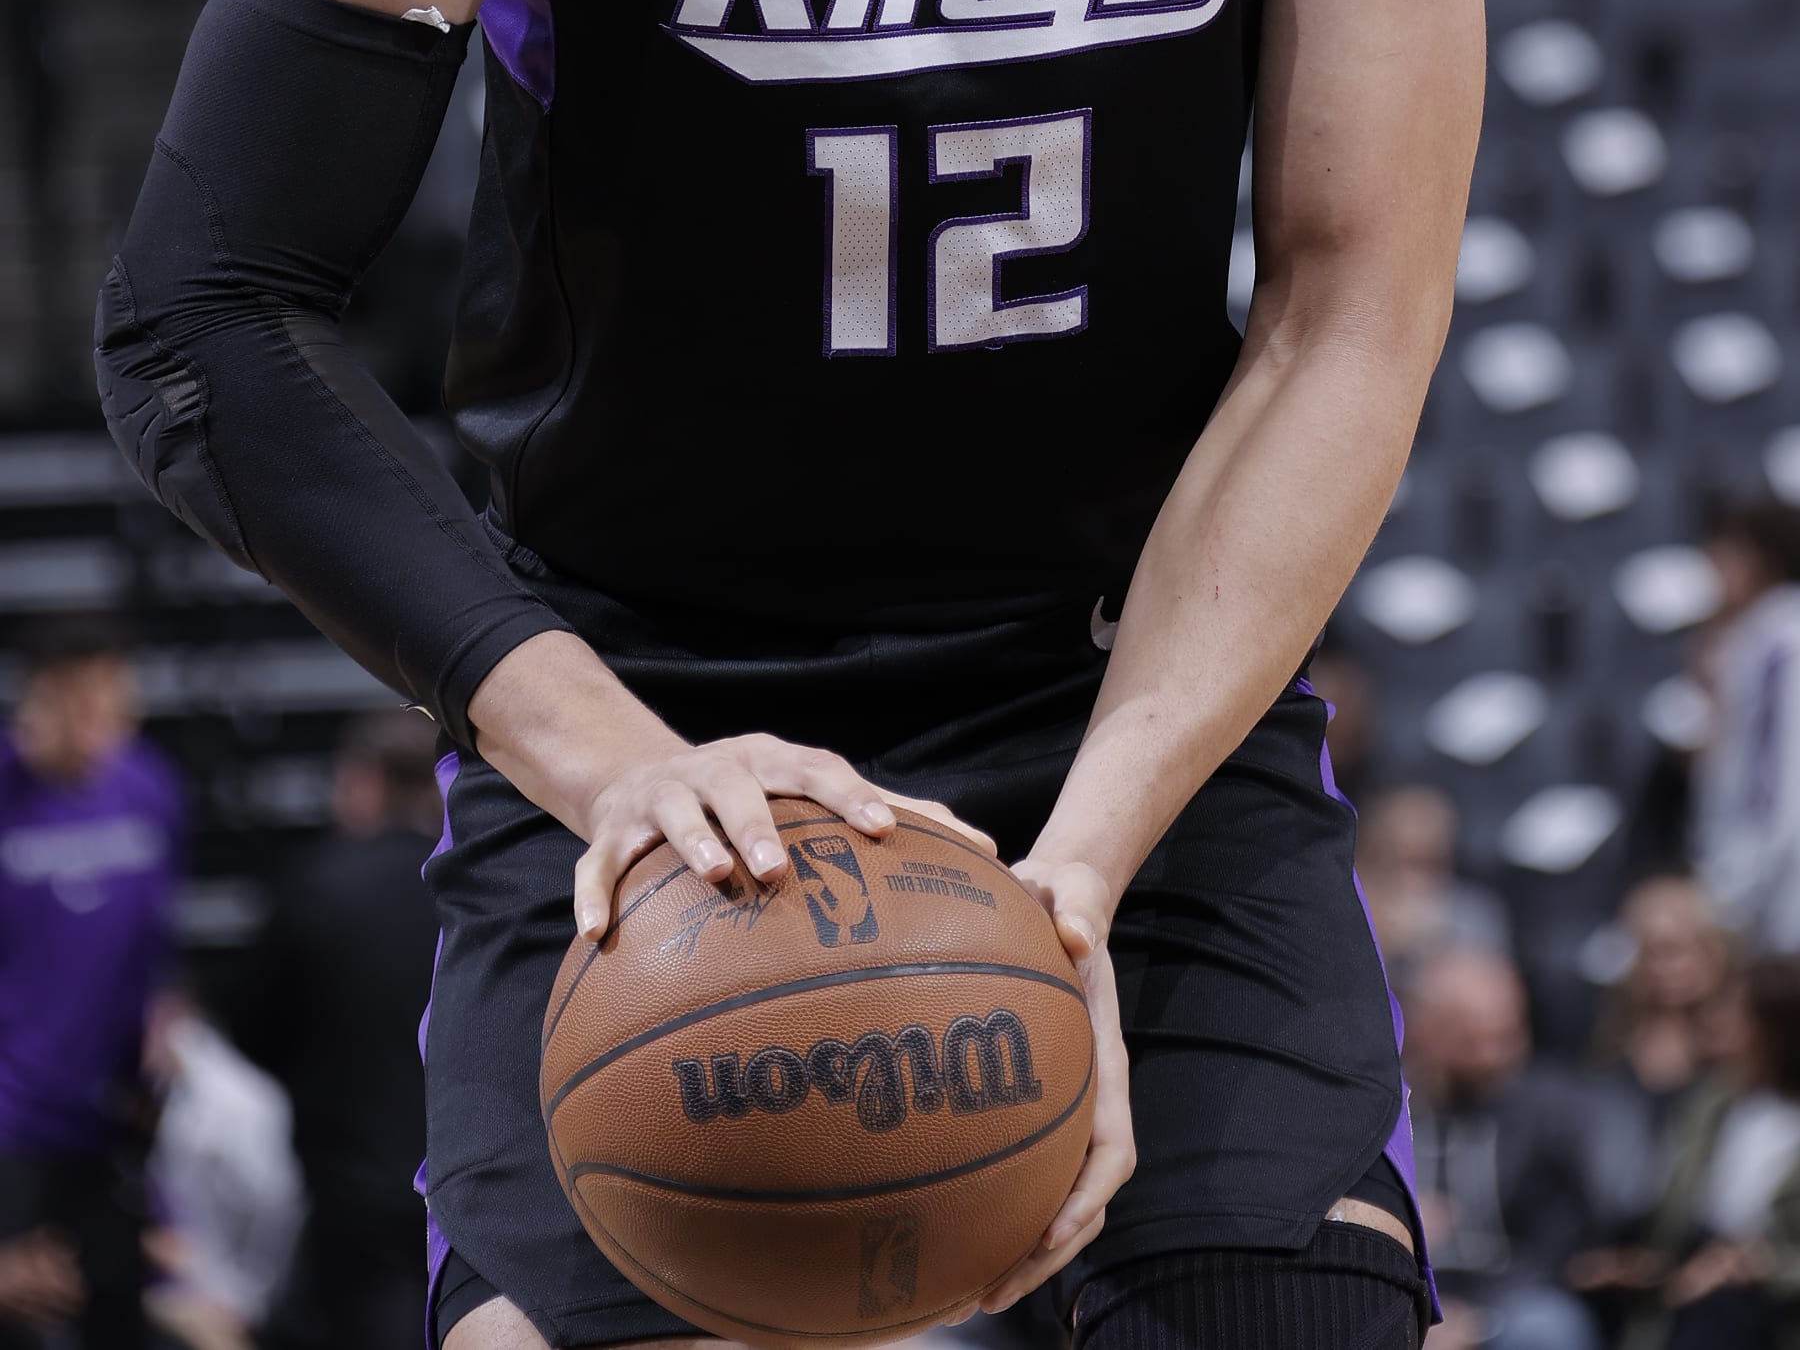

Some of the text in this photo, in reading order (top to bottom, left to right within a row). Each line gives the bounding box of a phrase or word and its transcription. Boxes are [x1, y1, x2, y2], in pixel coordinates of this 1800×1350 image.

[805, 107, 1092, 358] 12
[883, 874, 997, 910] OFFICIAL GAME BALL
[901, 861, 972, 883] GENUINE LEATHER
[672, 1008, 1043, 1133] Wilson
